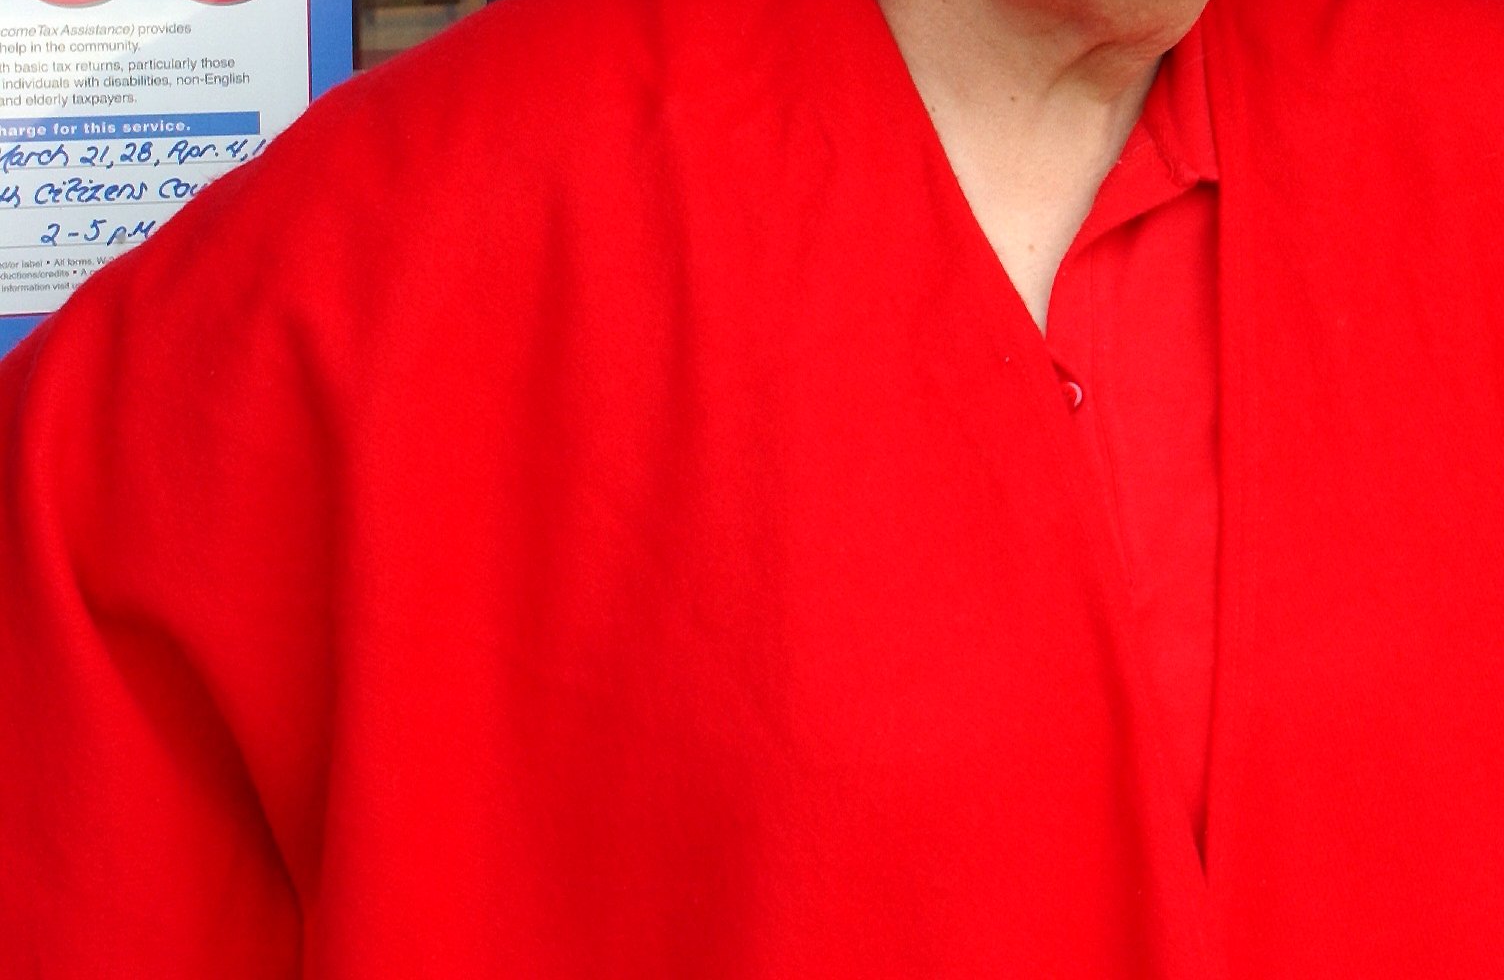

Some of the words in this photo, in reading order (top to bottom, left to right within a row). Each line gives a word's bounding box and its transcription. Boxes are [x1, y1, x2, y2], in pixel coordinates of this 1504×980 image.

[38, 25, 59, 37] Tax
[60, 23, 136, 38] Assistance)
[137, 23, 192, 39] provides
[30, 40, 43, 53] in
[45, 39, 66, 53] the
[69, 38, 141, 54] community.
[14, 60, 49, 74] basic
[52, 61, 72, 73] tax
[75, 60, 125, 75] returns,
[127, 57, 198, 74] particularly
[200, 57, 236, 69] those
[2, 76, 71, 90] individuals
[73, 75, 100, 89] with
[102, 74, 173, 89] disabilities,
[175, 72, 251, 88] non-English
[0, 94, 22, 107] and
[25, 93, 69, 109] elderly
[71, 91, 138, 107] taxpayers.
[53, 123, 79, 136] for
[83, 122, 117, 135] this
[122, 121, 192, 134] service.
[1, 283, 51, 294] information
